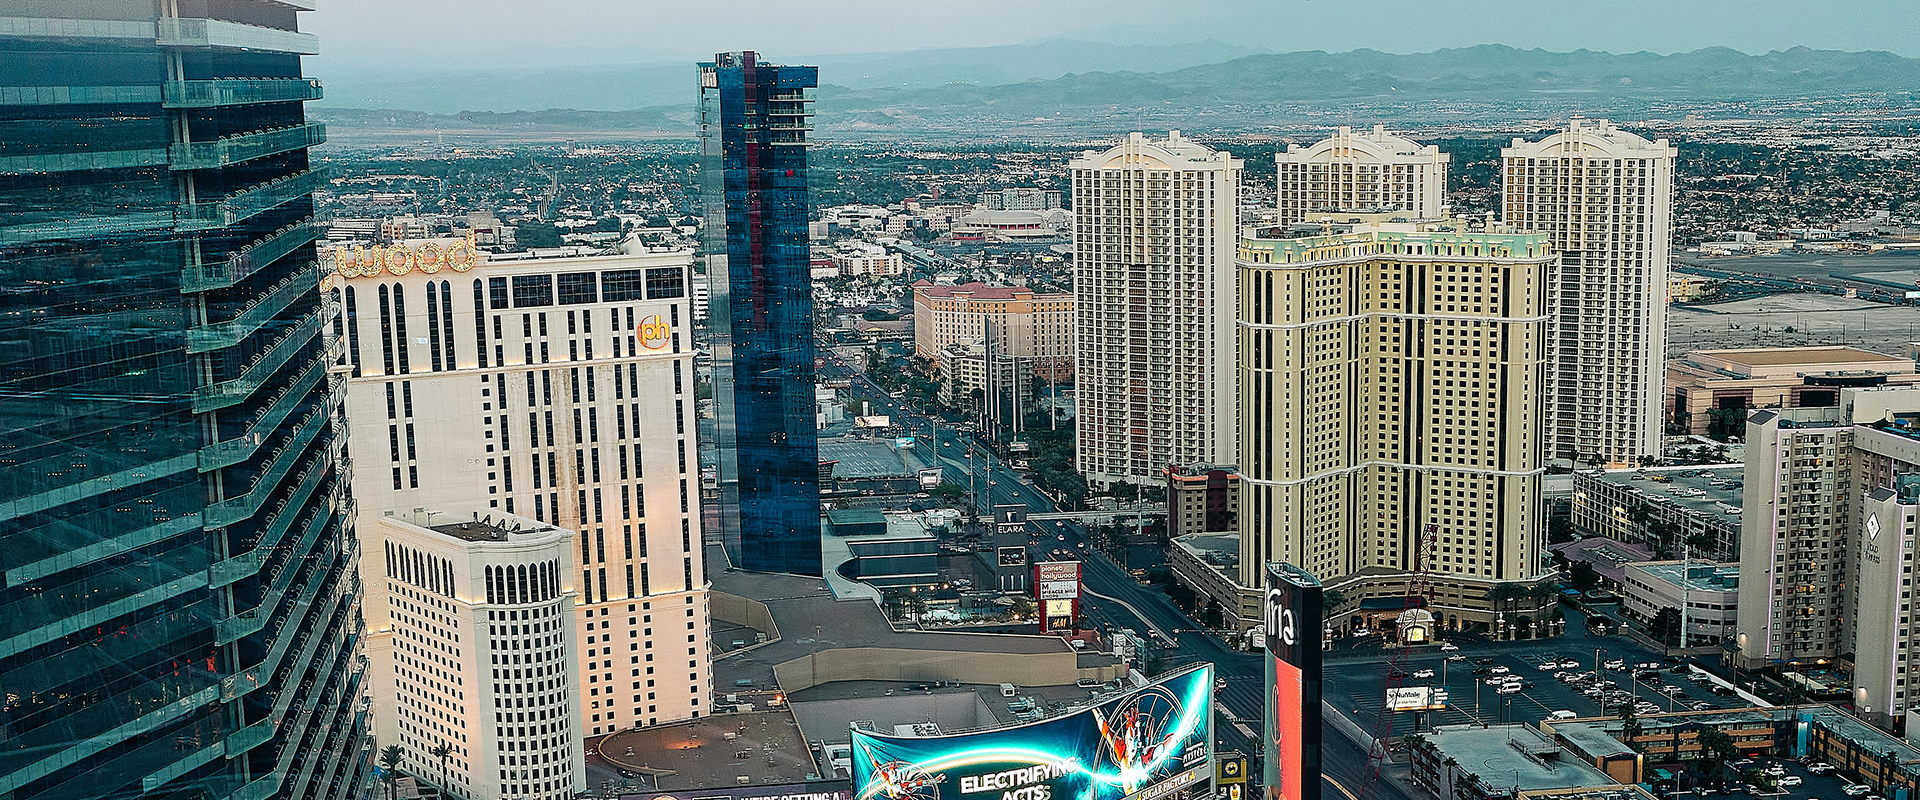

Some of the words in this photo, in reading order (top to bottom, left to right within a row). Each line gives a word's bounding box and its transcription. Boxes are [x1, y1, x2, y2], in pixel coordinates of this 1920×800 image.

[322, 228, 477, 286] wood
[641, 314, 670, 346] ph
[997, 525, 1025, 534] ELARA
[1041, 571, 1077, 580] hollywood
[960, 756, 1078, 794] ELECTRIFYING
[1141, 784, 1163, 800] SUGAR
[1162, 772, 1190, 792] FACTORY
[1001, 784, 1047, 800] ACTS
